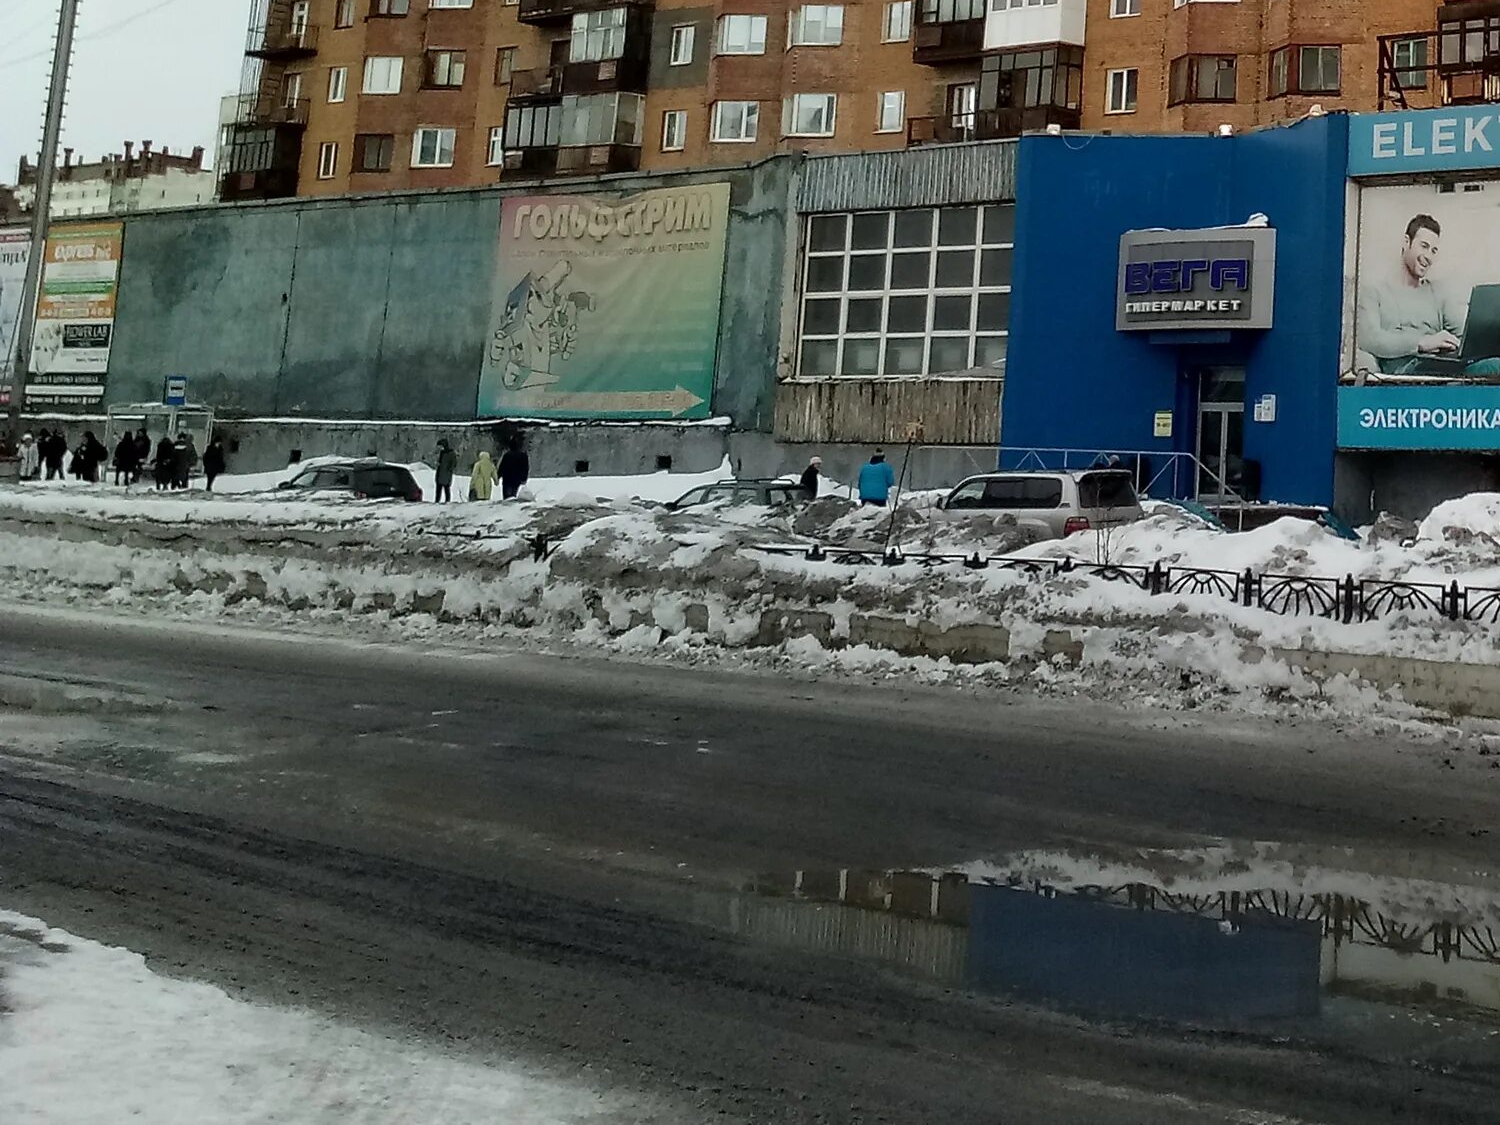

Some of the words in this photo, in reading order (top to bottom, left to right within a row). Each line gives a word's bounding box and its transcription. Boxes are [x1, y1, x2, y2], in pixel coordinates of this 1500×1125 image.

[513, 192, 712, 242] ГОЛЬФСТРИМ
[1125, 259, 1250, 295] ВЕГА
[1125, 299, 1242, 314] ГИПЕРМАРКЕТ
